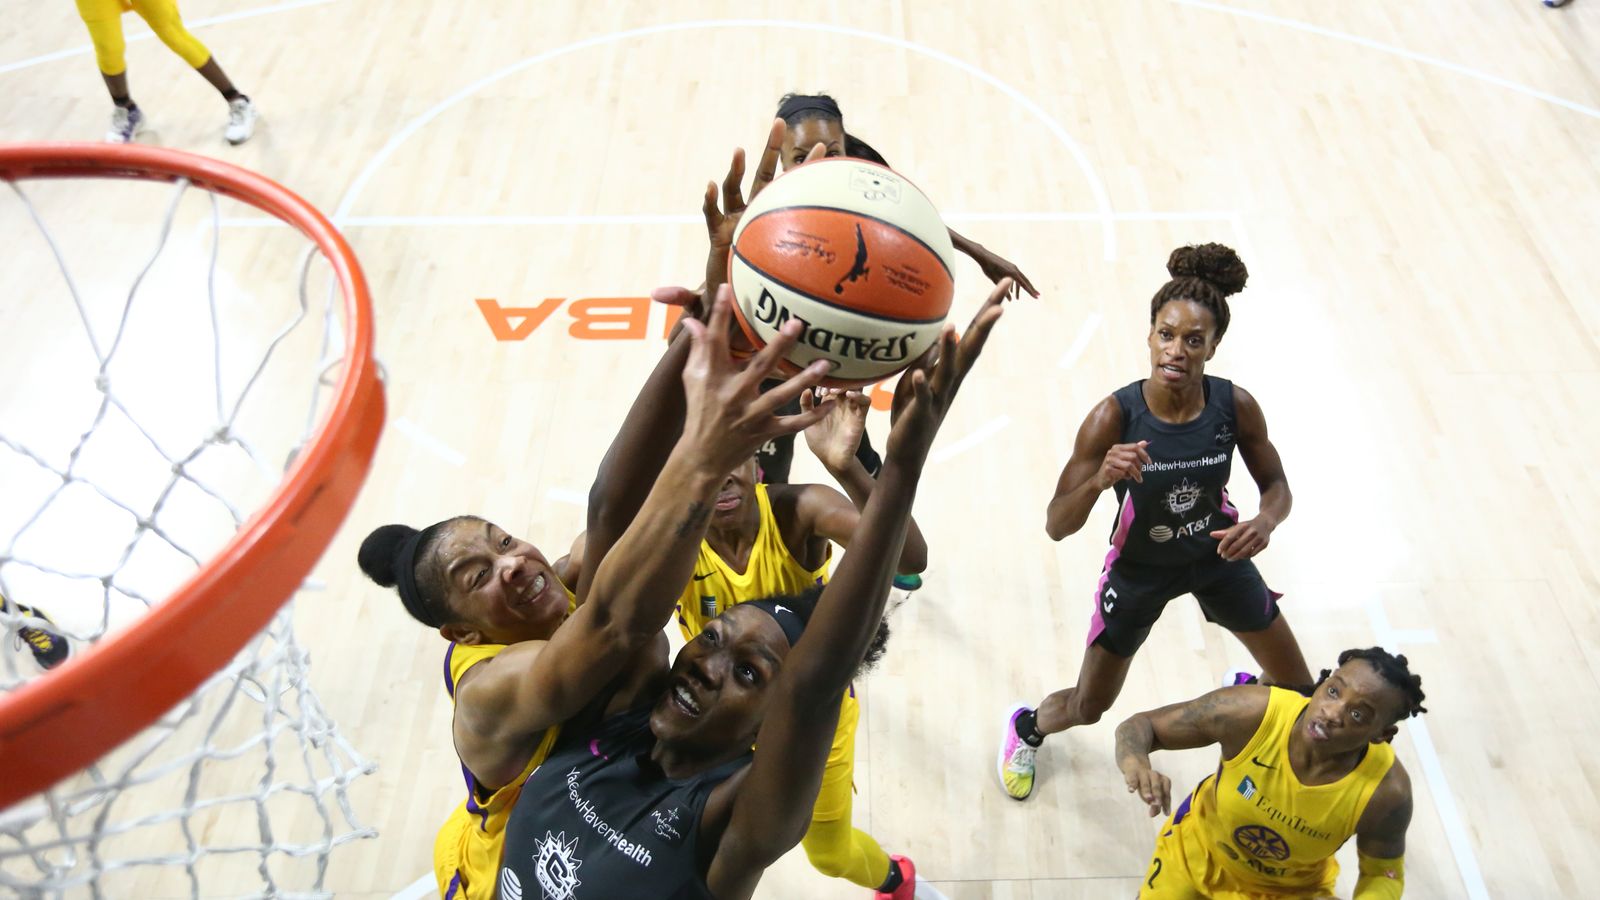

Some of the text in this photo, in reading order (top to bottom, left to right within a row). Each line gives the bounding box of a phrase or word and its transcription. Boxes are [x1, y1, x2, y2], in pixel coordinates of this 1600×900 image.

[1141, 452, 1228, 473] aleNewHavenHealth
[1176, 513, 1213, 539] AT&T
[1255, 795, 1332, 842] EquiTrust
[1147, 857, 1162, 890] 2
